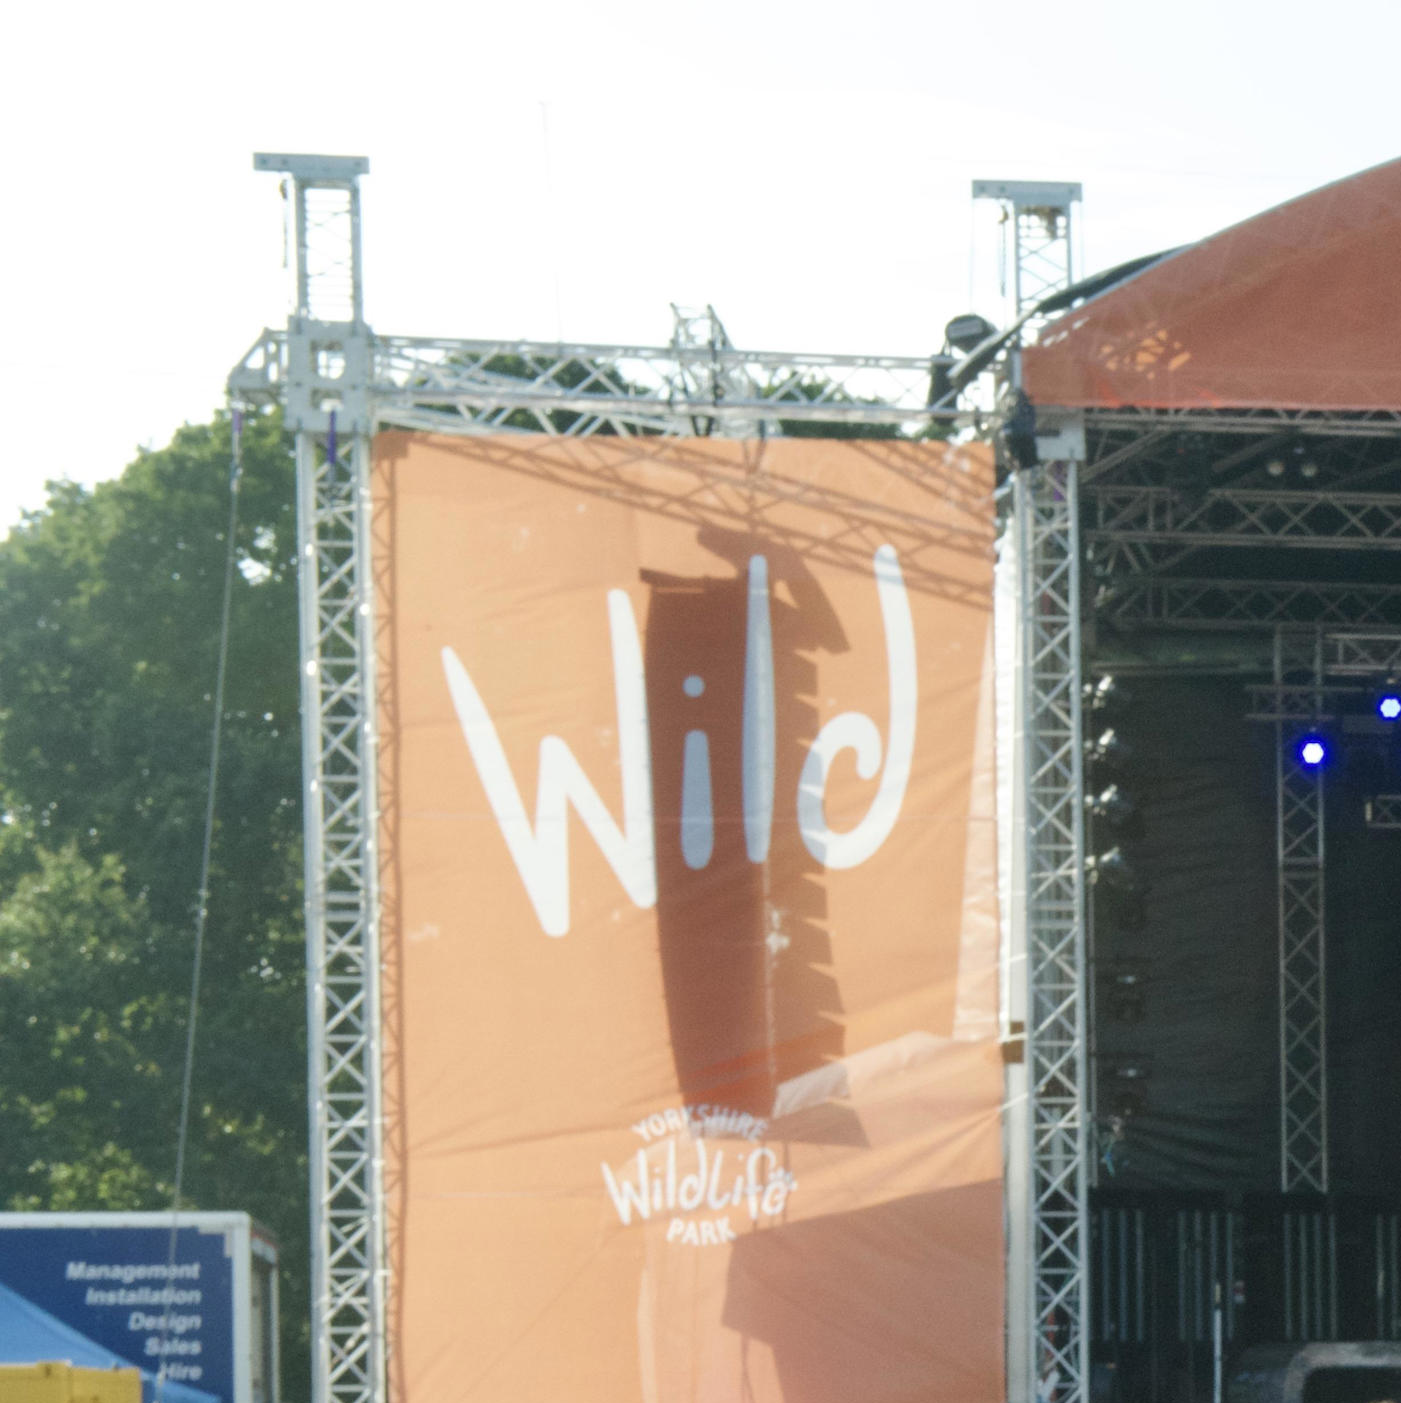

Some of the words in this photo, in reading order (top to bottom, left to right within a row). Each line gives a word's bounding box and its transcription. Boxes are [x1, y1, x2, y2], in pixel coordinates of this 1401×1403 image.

[441, 543, 918, 938] Wild
[630, 1104, 769, 1142] YORKSHIRE
[666, 1216, 737, 1246] PARK
[66, 1261, 200, 1283] Management
[85, 1287, 202, 1306] Installation
[128, 1311, 202, 1333] Design
[144, 1336, 202, 1356] Sales
